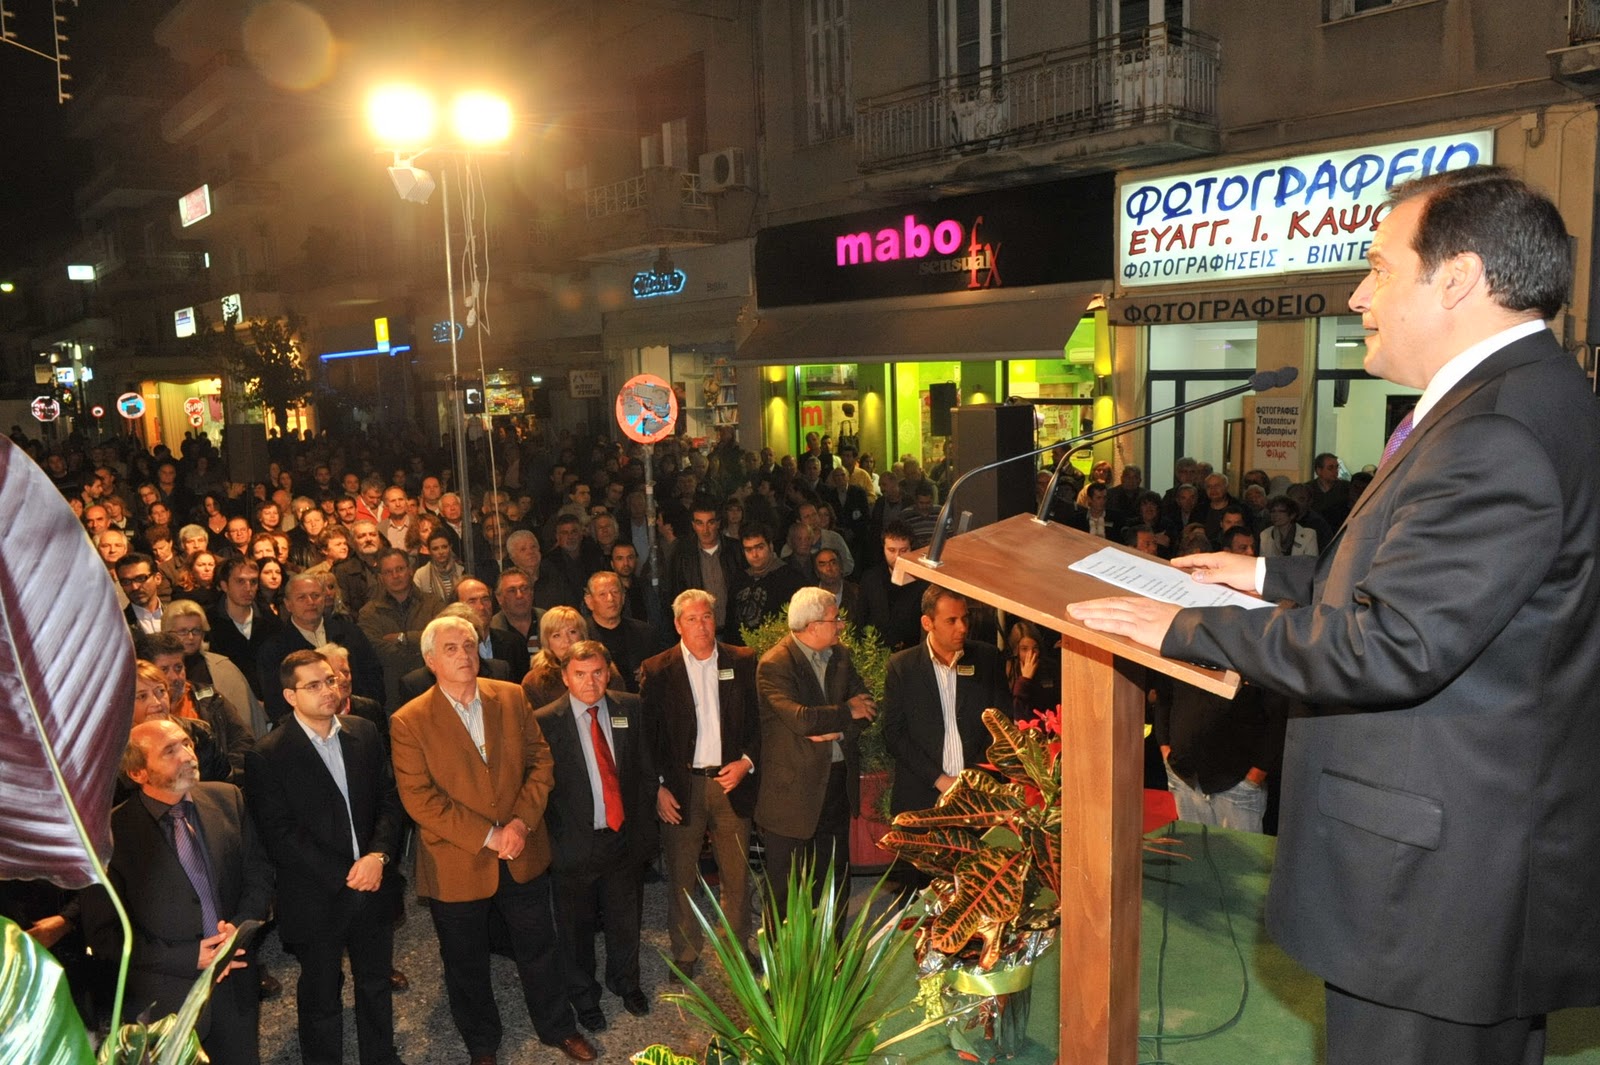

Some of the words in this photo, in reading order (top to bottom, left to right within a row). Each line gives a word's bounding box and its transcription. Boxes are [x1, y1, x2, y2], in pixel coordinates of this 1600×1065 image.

[1126, 142, 1480, 225] ΦΩΤΟΓΡΑΦΕΙΟ
[836, 214, 964, 267] mabo
[1128, 219, 1233, 256] ΕΥΑΓΓ.
[919, 249, 992, 276] sensual
[1123, 249, 1278, 280] ΦΩΤΟΓΡΑΦΗΣΕΙΣ
[1306, 240, 1372, 264] ΒΙΝΤΕ
[1123, 293, 1326, 324] ΦΩΤΟΓΡΑΦΕΙΟ
[1255, 406, 1299, 415] ΦΩΤΟΓΡΑΦΙΕΣ
